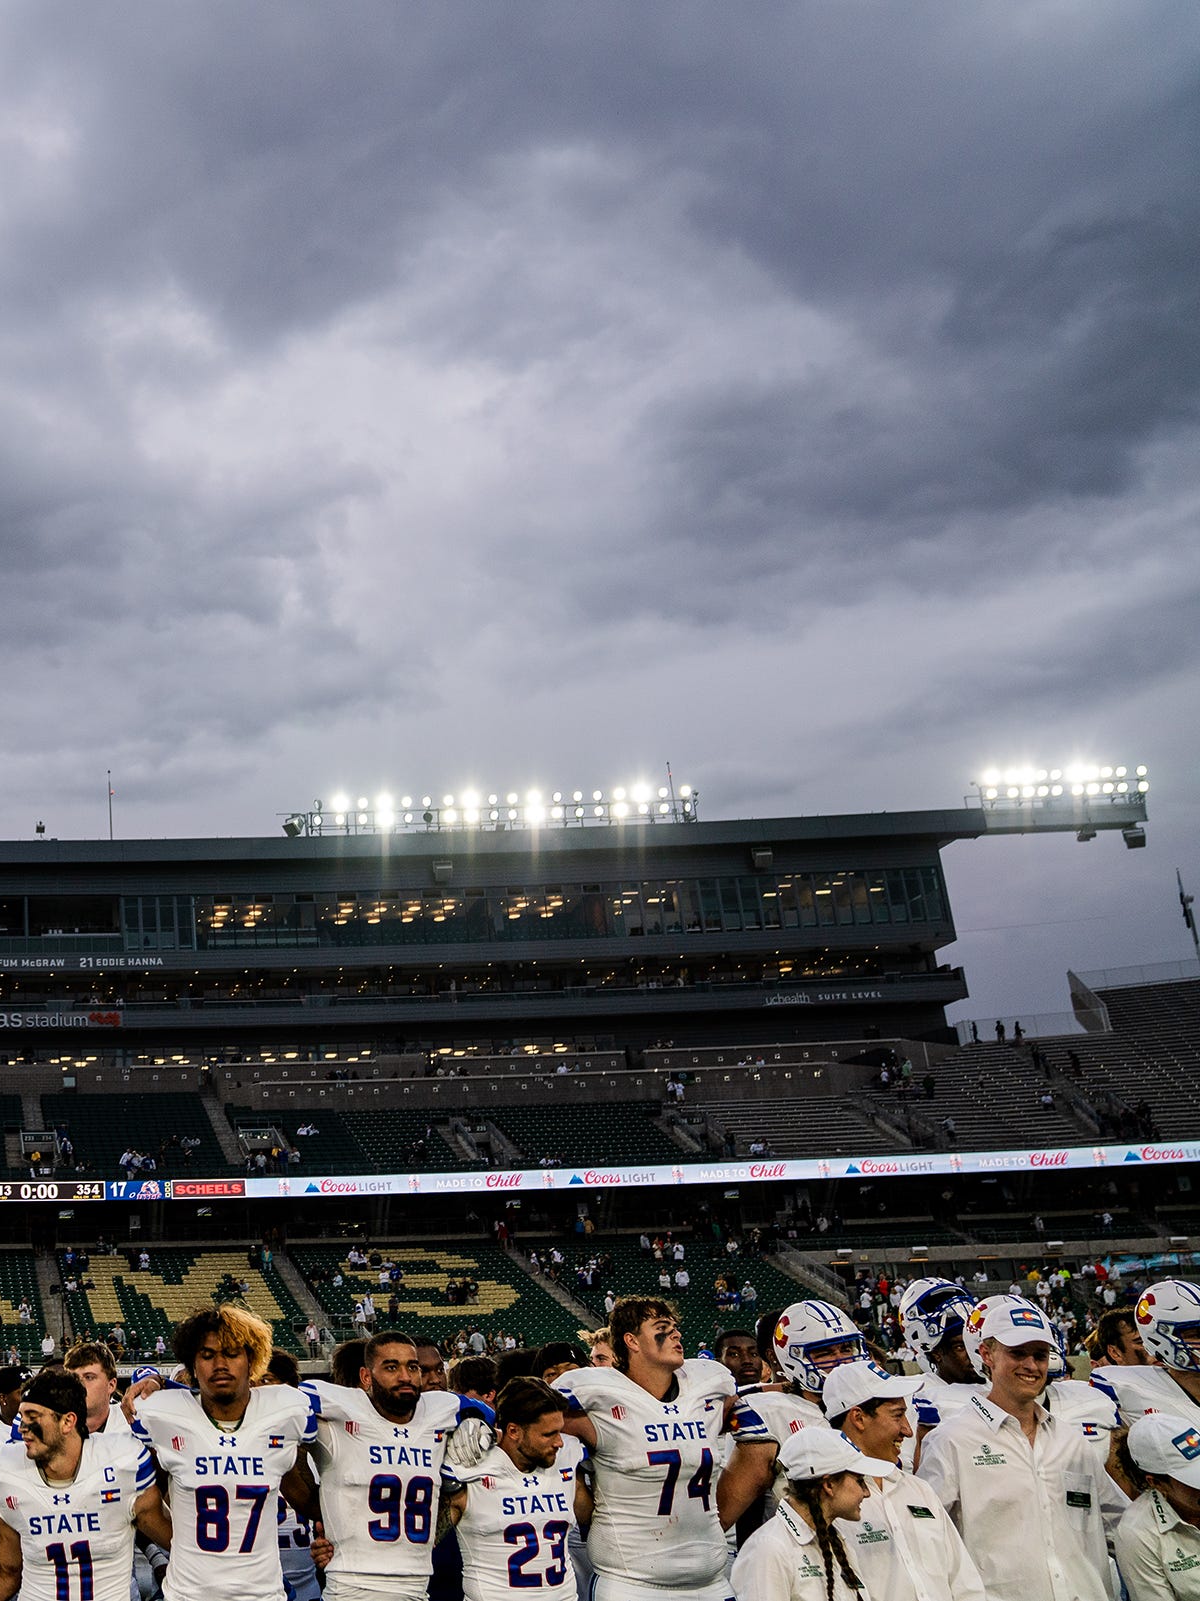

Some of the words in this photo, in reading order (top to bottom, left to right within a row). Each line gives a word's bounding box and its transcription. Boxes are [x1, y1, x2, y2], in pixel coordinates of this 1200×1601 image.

[21, 959, 65, 968] McGRAW
[79, 957, 93, 968] 21
[96, 958, 125, 967] EDDIE
[128, 957, 163, 966] HANNA
[765, 991, 810, 1004] uchealth
[818, 993, 847, 1001] SUITE
[852, 991, 882, 999] LEVEL
[26, 1012, 89, 1028] stadium
[978, 1158, 1009, 1167] MADE
[1011, 1157, 1026, 1166] TO
[1029, 1152, 1069, 1167] Chill
[1140, 1146, 1185, 1161] Coors
[700, 1170, 730, 1178] MADE
[733, 1168, 747, 1177] TO
[749, 1163, 787, 1178] Chill
[860, 1159, 898, 1173] Coors
[899, 1161, 933, 1172] LIGHT
[436, 1179, 466, 1188] MADE
[469, 1178, 483, 1187] TO
[485, 1173, 523, 1187] Chill
[583, 1170, 621, 1184] Coors
[622, 1173, 657, 1183] LIGHT
[20, 1184, 58, 1199] 0:00
[109, 1182, 127, 1197] 17
[174, 1183, 242, 1195] SCHEELS
[320, 1178, 358, 1193] Coors
[359, 1182, 393, 1191] LIGHT
[971, 1396, 995, 1422] CINCH
[644, 1420, 707, 1443] STATE
[369, 1445, 432, 1468] STATE
[195, 1456, 264, 1476] STATE
[104, 1467, 115, 1483] C
[647, 1447, 715, 1516] 74
[368, 1473, 434, 1545] 98
[503, 1493, 569, 1516] STATE
[1152, 1491, 1167, 1524] INCH
[29, 1512, 100, 1536] STATE
[194, 1484, 270, 1554] 87
[777, 1505, 801, 1537] CINCH
[503, 1520, 570, 1588] 23
[45, 1540, 94, 1601] 11
